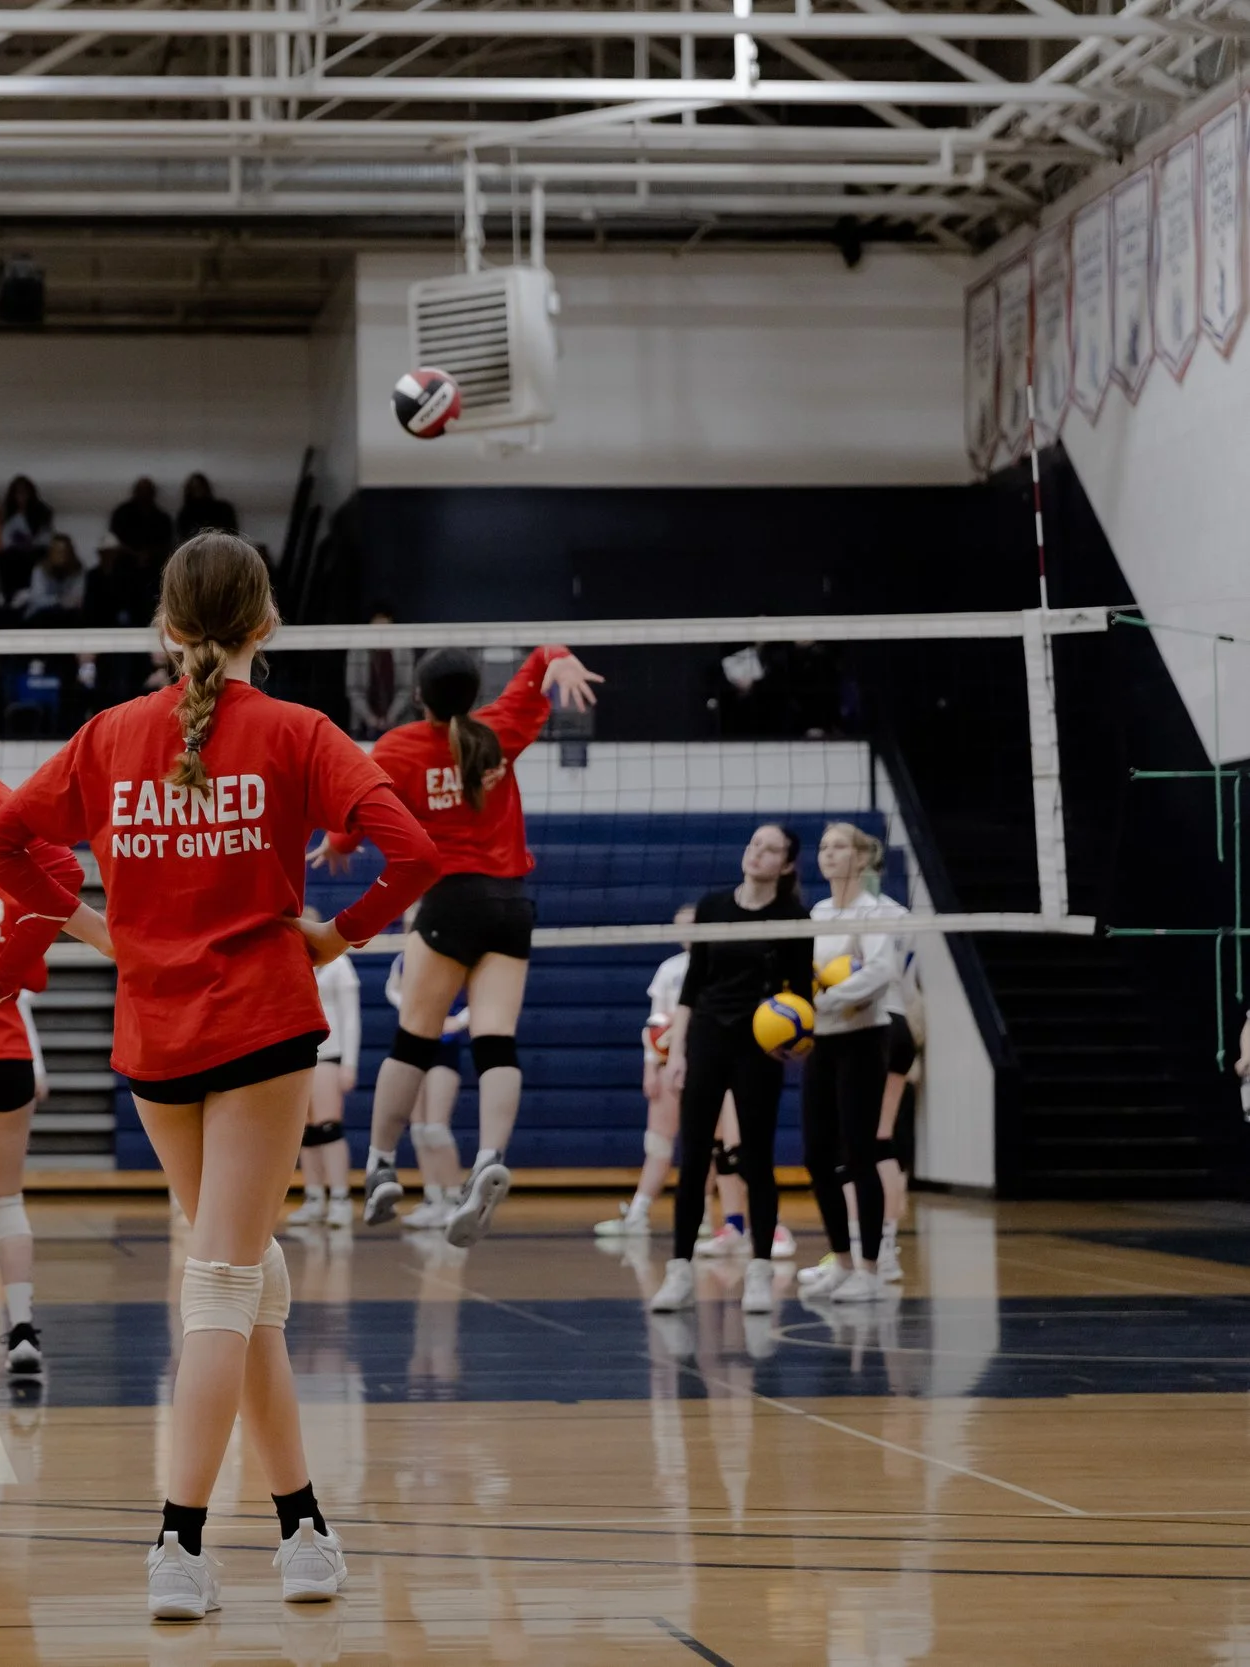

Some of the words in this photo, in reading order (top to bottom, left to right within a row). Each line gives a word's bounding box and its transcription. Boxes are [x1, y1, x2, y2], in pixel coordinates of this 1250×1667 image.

[111, 774, 266, 826] EARNED
[111, 833, 169, 859] NOT
[176, 826, 271, 859] GIVEN.
